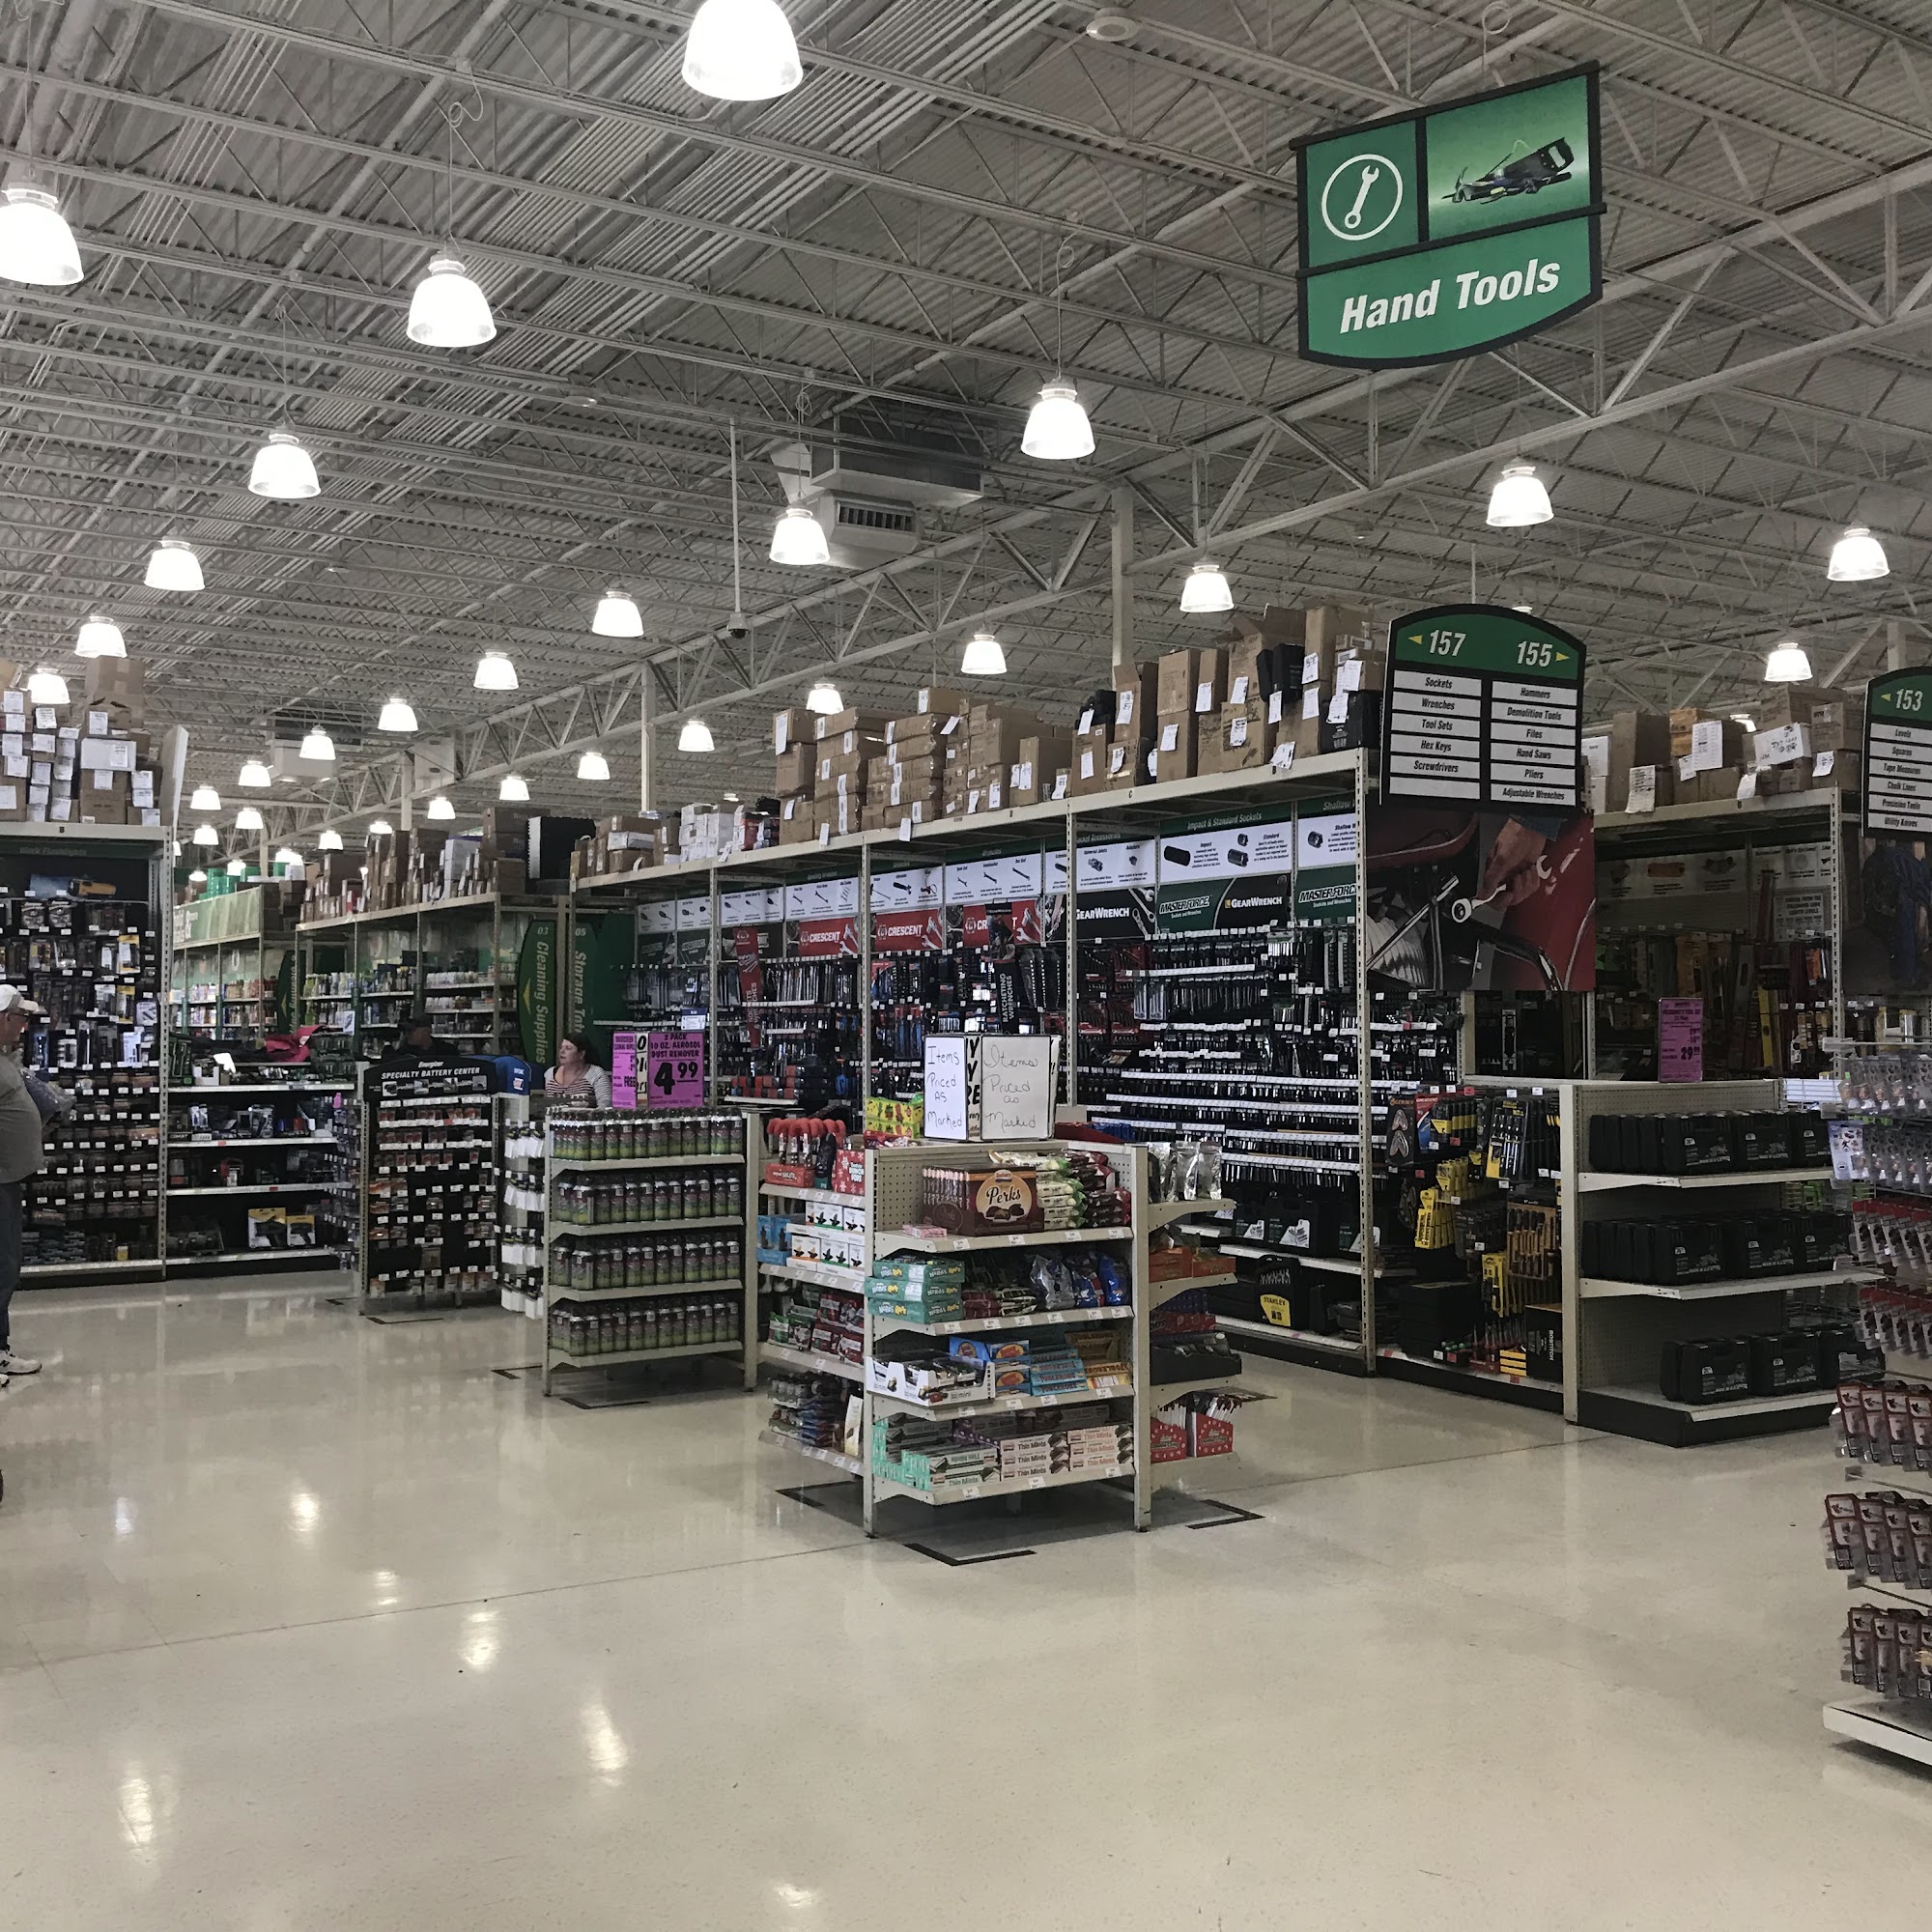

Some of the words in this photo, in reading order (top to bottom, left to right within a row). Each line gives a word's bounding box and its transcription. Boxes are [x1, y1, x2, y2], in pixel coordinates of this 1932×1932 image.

[1339, 279, 1442, 334] Hand
[1456, 258, 1561, 310] Tools
[1429, 629, 1466, 656] 157
[1517, 640, 1553, 668] 155
[1425, 677, 1452, 690] Sockets
[1520, 687, 1551, 699] Hammers
[1895, 688, 1923, 712] 153
[1421, 697, 1455, 710] Wrenches
[1507, 707, 1543, 719] Demolition
[1544, 710, 1562, 721] Tools
[1421, 719, 1436, 729] Tool
[1437, 720, 1453, 731] Sets
[1526, 728, 1543, 739] Files
[1421, 740, 1435, 751] Hex
[1435, 741, 1452, 753] Keys
[1516, 748, 1533, 758] Hand
[1534, 749, 1551, 760] Saws
[1414, 760, 1458, 773] Screwdrivers
[1524, 768, 1544, 780] Pliers
[1502, 787, 1535, 799] Adjustable
[1323, 800, 1351, 811] Shallow
[1187, 820, 1207, 830] Impact
[1208, 819, 1212, 827] &
[1213, 815, 1238, 826] Standard
[1239, 812, 1262, 823] Sockets
[1299, 883, 1356, 903] MASTERFORC
[1159, 895, 1211, 914] MASTERFORCE
[810, 931, 841, 943] CRESCENT
[888, 925, 923, 937] CRESCENT
[534, 941, 549, 1001] Cleaning
[1000, 973, 1009, 1022] RATCHETING
[1006, 975, 1015, 1020] WRENCHES
[534, 1004, 549, 1064] Supplies
[927, 1046, 960, 1065] Items
[983, 1044, 1038, 1068] Items
[381, 1071, 420, 1079] SPECIALTY
[421, 1069, 452, 1077] BATTERY
[926, 1072, 957, 1088] Priced
[983, 1074, 1031, 1093] Priced
[935, 1091, 947, 1102] AS
[927, 1111, 962, 1130] Marked
[985, 1111, 1036, 1134] Marked
[986, 1186, 1021, 1205] Perks
[1263, 1297, 1285, 1306] STANLEY
